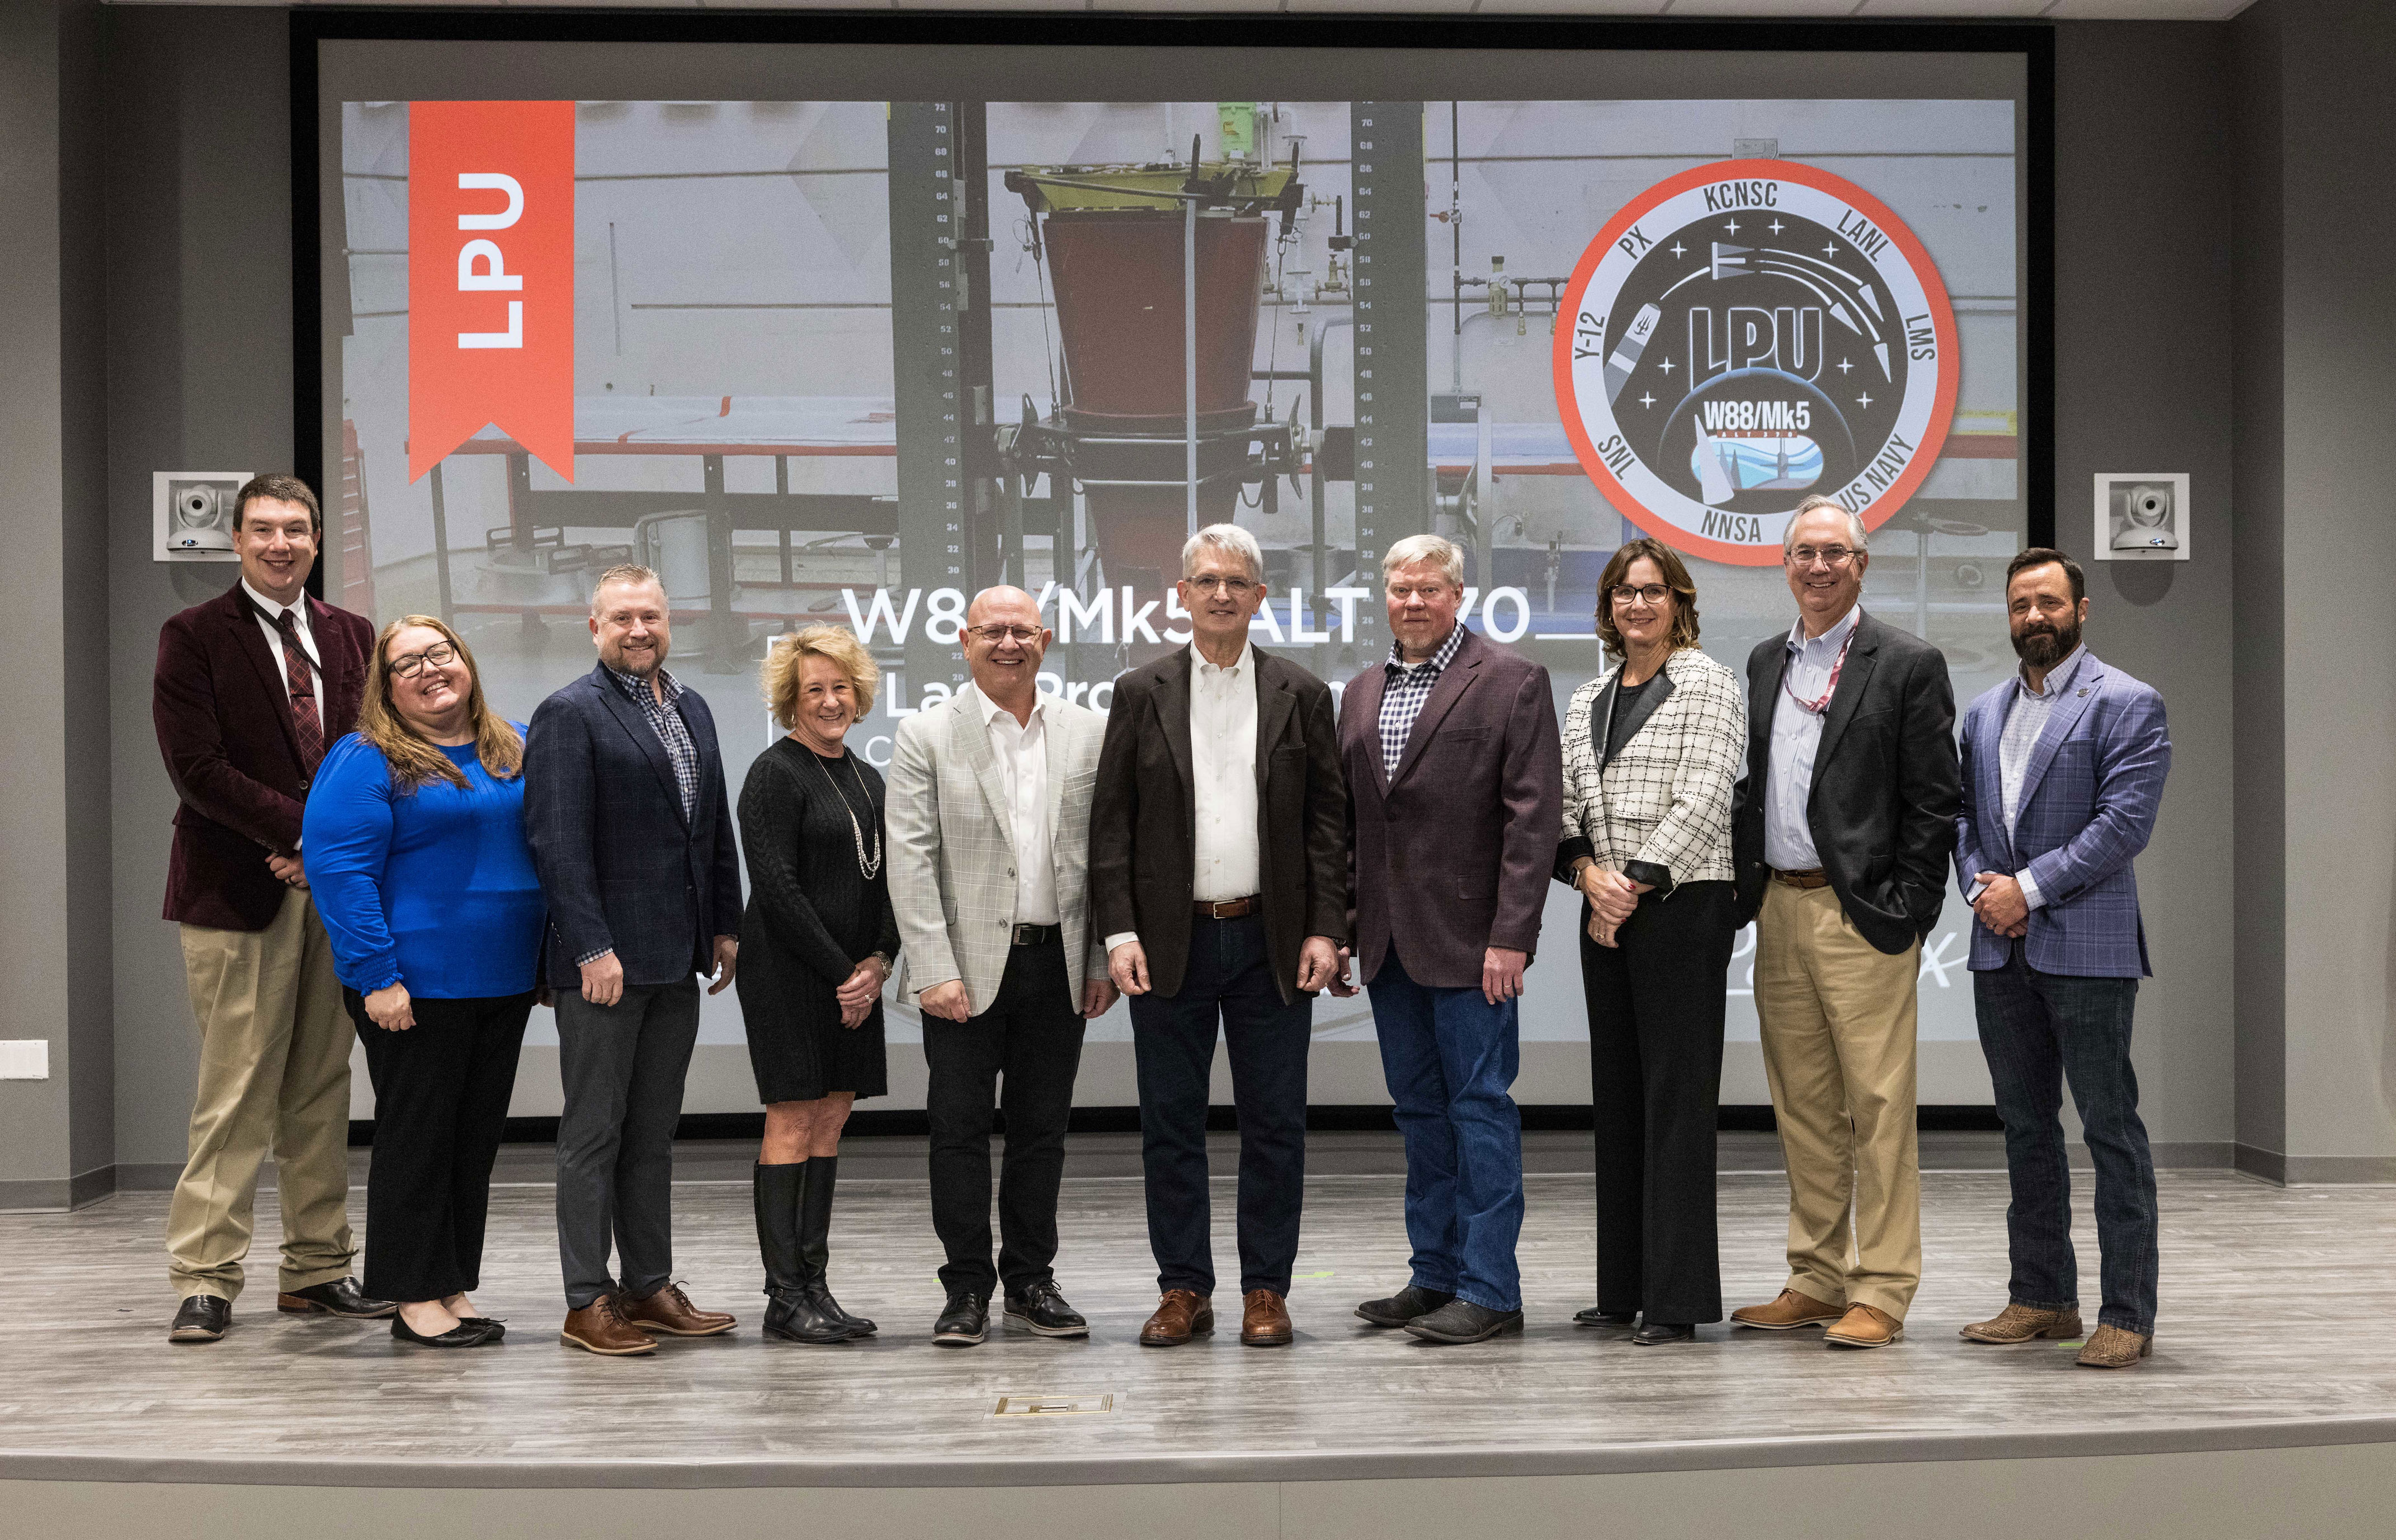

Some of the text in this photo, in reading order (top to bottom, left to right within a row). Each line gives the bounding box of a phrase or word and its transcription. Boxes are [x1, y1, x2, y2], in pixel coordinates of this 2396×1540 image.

[935, 103, 946, 112] 72
[1361, 118, 1373, 127] 70
[935, 125, 947, 134] 70
[1359, 187, 1372, 196] 64
[936, 192, 948, 201] 64
[1703, 181, 1778, 212] KCNSC
[936, 214, 948, 223] 62
[1359, 210, 1371, 219] 62
[1836, 209, 1889, 263] LANL
[1617, 225, 1653, 260] PX
[457, 173, 524, 349] LPU
[1359, 301, 1372, 309] 54
[1360, 324, 1371, 332] 52
[1574, 311, 1605, 360] Y-12
[1906, 313, 1936, 361] LMS
[941, 347, 952, 356] 50
[1360, 347, 1372, 356] 50
[1690, 307, 1822, 391] LPU
[1360, 415, 1373, 424] 44
[1704, 401, 1810, 430] W88/Mk5
[1360, 438, 1373, 447] 42
[944, 457, 956, 466] 40
[1598, 434, 1635, 480] SNL
[1361, 460, 1374, 469] 40
[1838, 433, 1914, 513] US NAVY
[946, 523, 958, 531] 34
[1701, 511, 1761, 542] NNSA
[1362, 528, 1374, 536] 34
[947, 545, 959, 553] 32
[1362, 550, 1374, 559] 32
[947, 566, 960, 574] 30
[841, 580, 1194, 644] W8/Mk5
[1455, 586, 1530, 644] 70
[1362, 616, 1374, 625] 26
[1362, 639, 1374, 647] 24
[952, 673, 964, 682] 20
